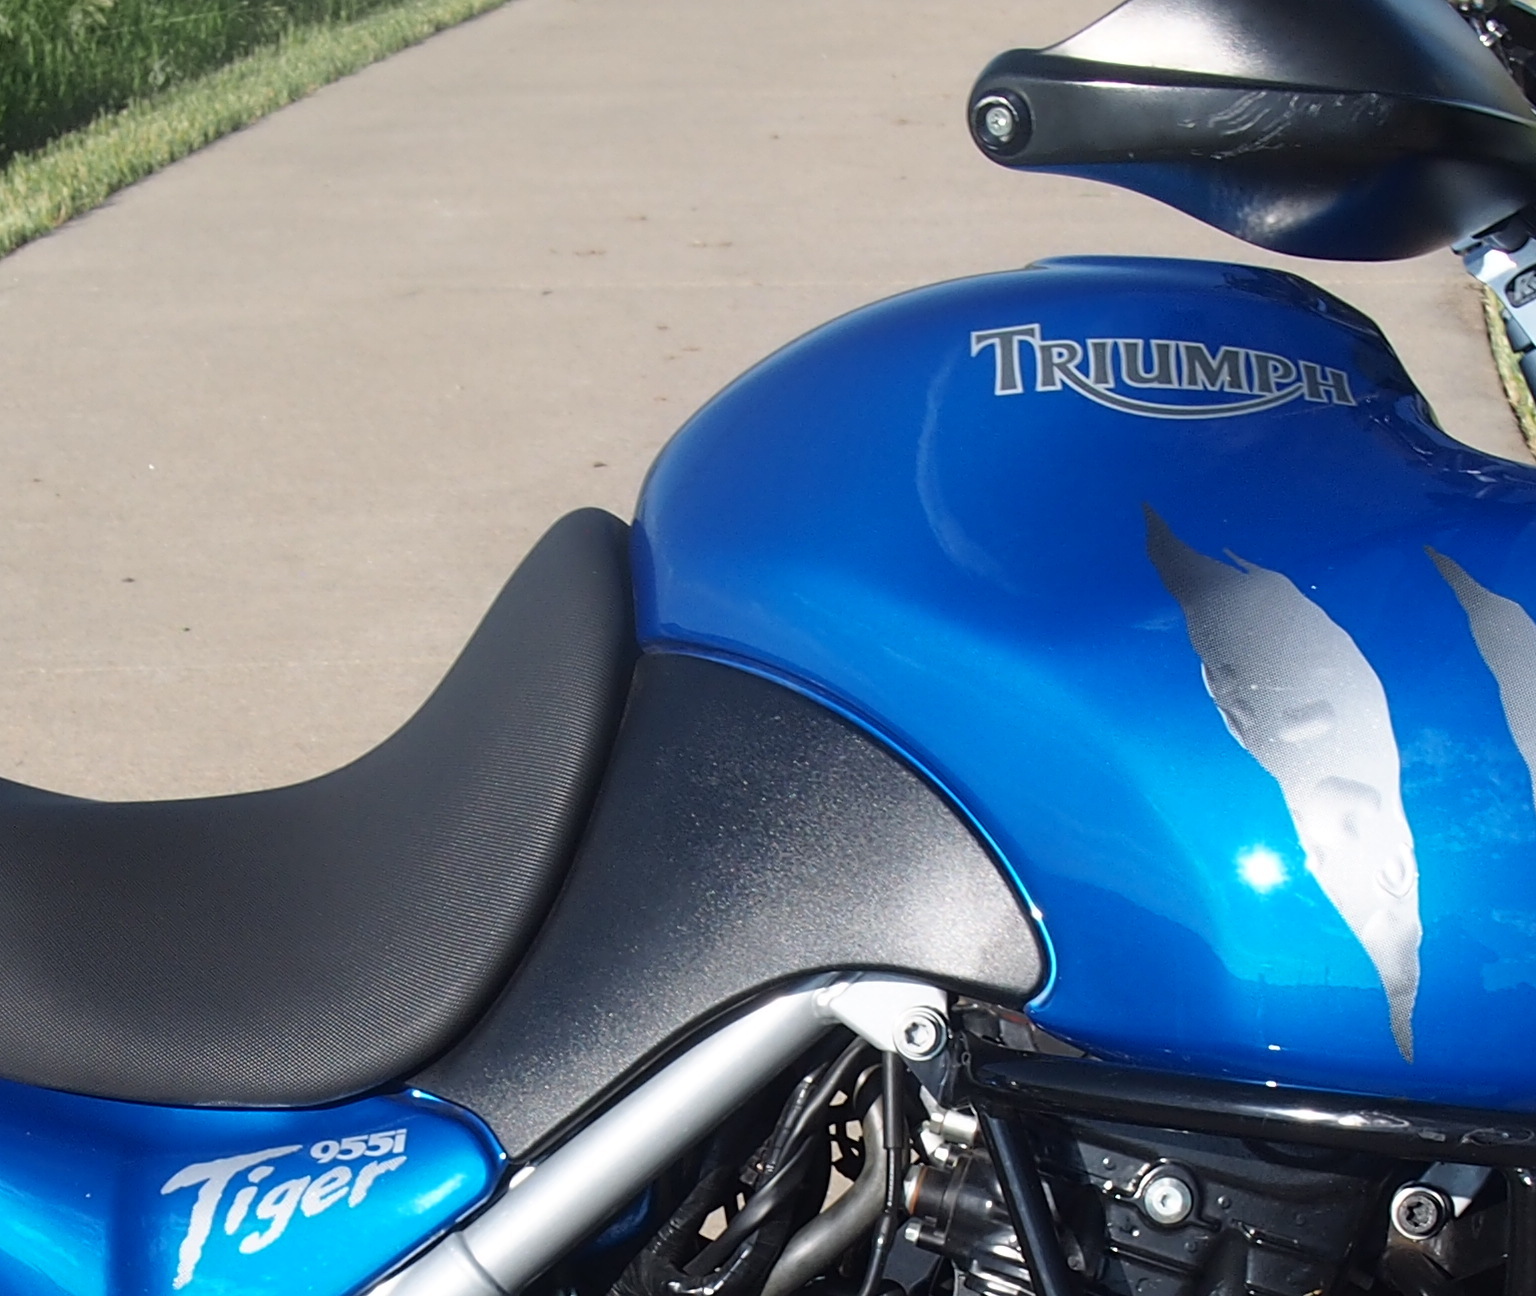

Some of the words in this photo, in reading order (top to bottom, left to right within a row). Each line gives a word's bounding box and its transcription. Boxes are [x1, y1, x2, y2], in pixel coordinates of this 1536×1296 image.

[971, 323, 1358, 420] TRIUMPH
[310, 1129, 407, 1164] 955i
[160, 1144, 407, 1290] Tiger
